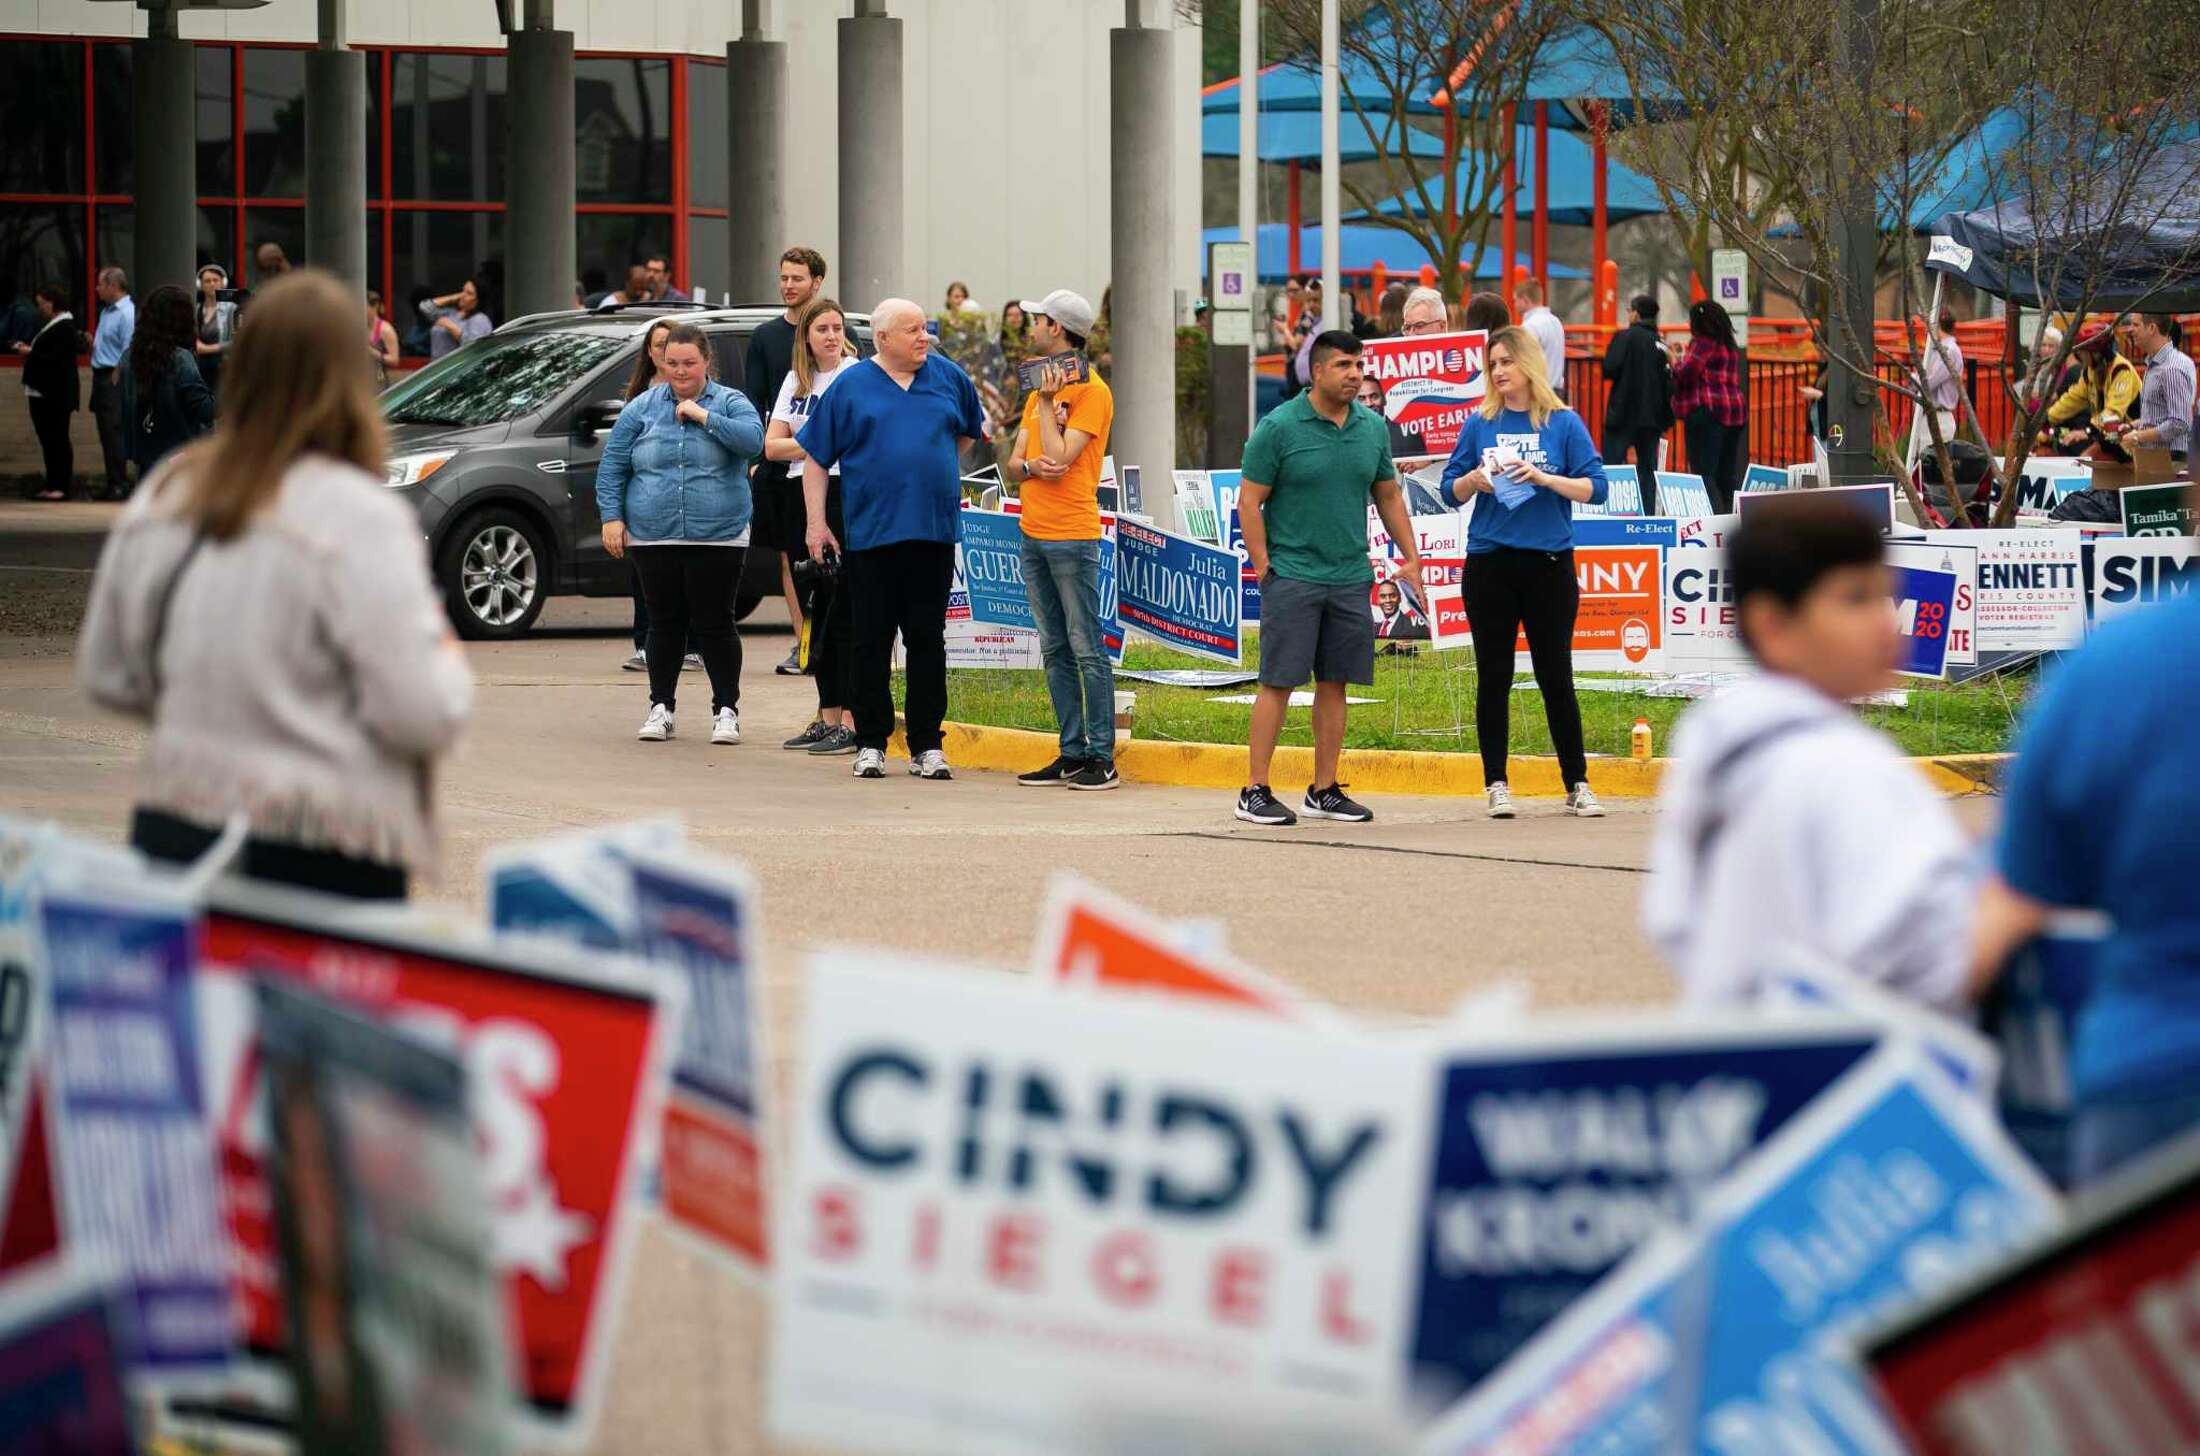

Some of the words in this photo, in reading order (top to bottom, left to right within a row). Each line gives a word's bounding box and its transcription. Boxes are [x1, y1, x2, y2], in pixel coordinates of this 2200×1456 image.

[1362, 347, 1483, 379] HAMPION
[1400, 416, 1434, 437] VOTE
[2130, 510, 2178, 524] Tamika
[1119, 521, 1166, 548] RE-ELECT
[1626, 524, 1673, 534] Re-Elect
[1124, 538, 1159, 557] JUDGE
[2018, 552, 2075, 560] HARRIS
[1188, 552, 1226, 581] Julia
[1978, 563, 2078, 589] ENNETT
[1120, 550, 1236, 628] MALDONADO
[2016, 592, 2076, 600] COUNTY
[1918, 601, 1945, 620] 20
[1151, 615, 1189, 637] DISTRICT
[1188, 629, 1219, 645] COURT
[1914, 620, 1942, 639] 20
[823, 1045, 1385, 1238] CINDY
[811, 1186, 1376, 1346] SIEGEL
